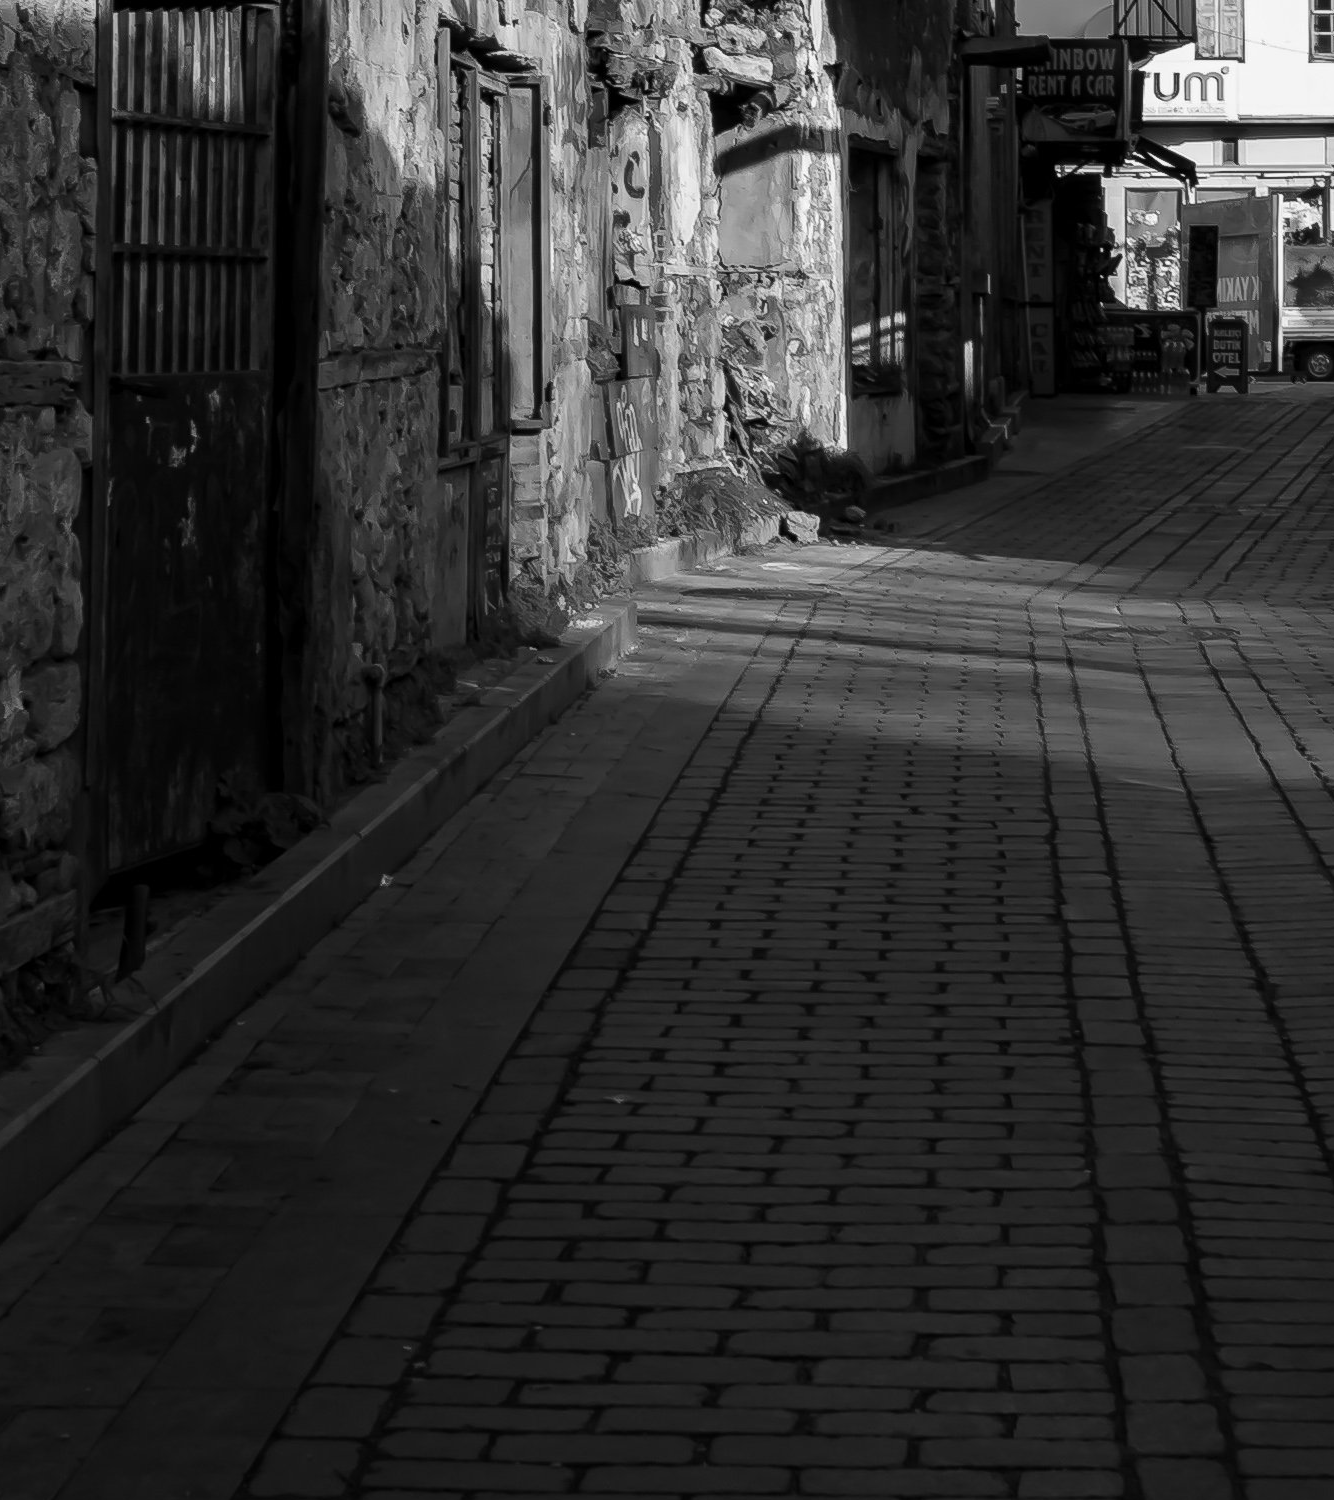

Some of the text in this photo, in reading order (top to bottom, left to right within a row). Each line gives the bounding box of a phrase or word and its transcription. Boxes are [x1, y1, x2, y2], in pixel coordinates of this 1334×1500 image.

[1028, 74, 1116, 97] RENT A CAR
[1212, 352, 1241, 364] OTEL
